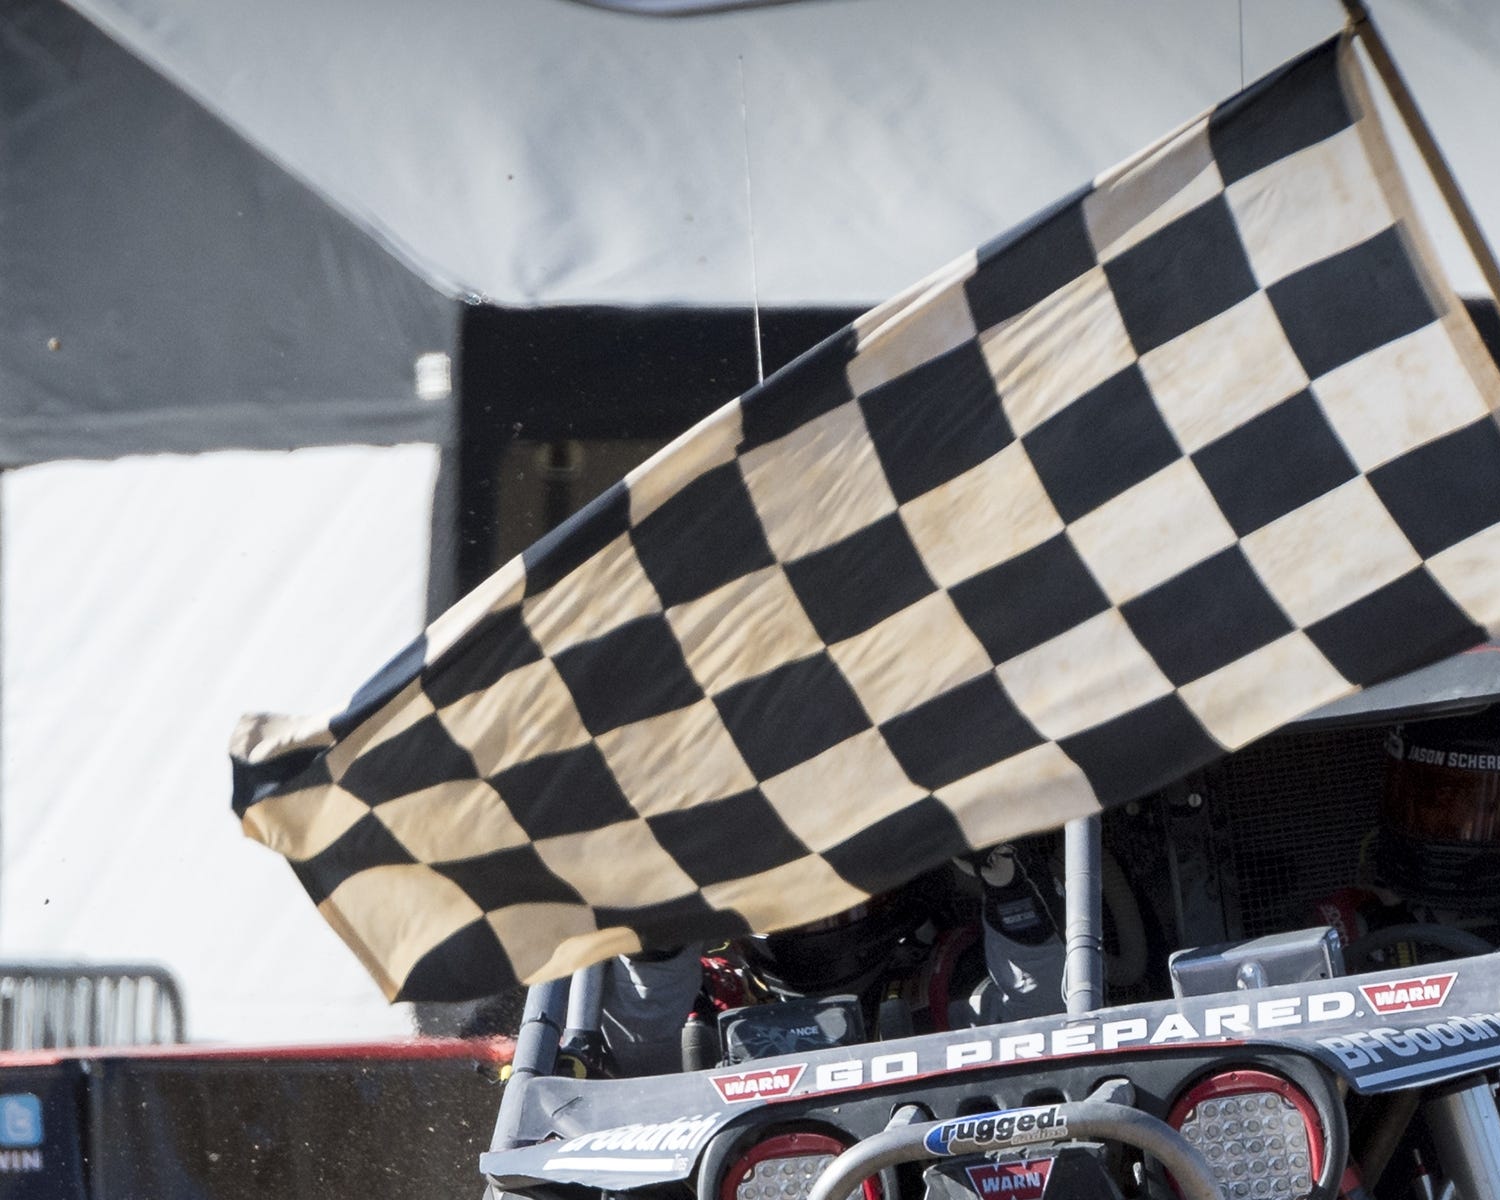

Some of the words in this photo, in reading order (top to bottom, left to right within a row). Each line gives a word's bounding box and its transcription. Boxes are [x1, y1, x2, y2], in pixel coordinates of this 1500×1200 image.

[1407, 745, 1445, 766] JASON
[724, 1074, 790, 1097] WARN
[815, 1051, 918, 1091] GO
[945, 991, 1366, 1071] PREPARED.
[1374, 984, 1441, 1007] WARN
[981, 1171, 1041, 1193] WARN
